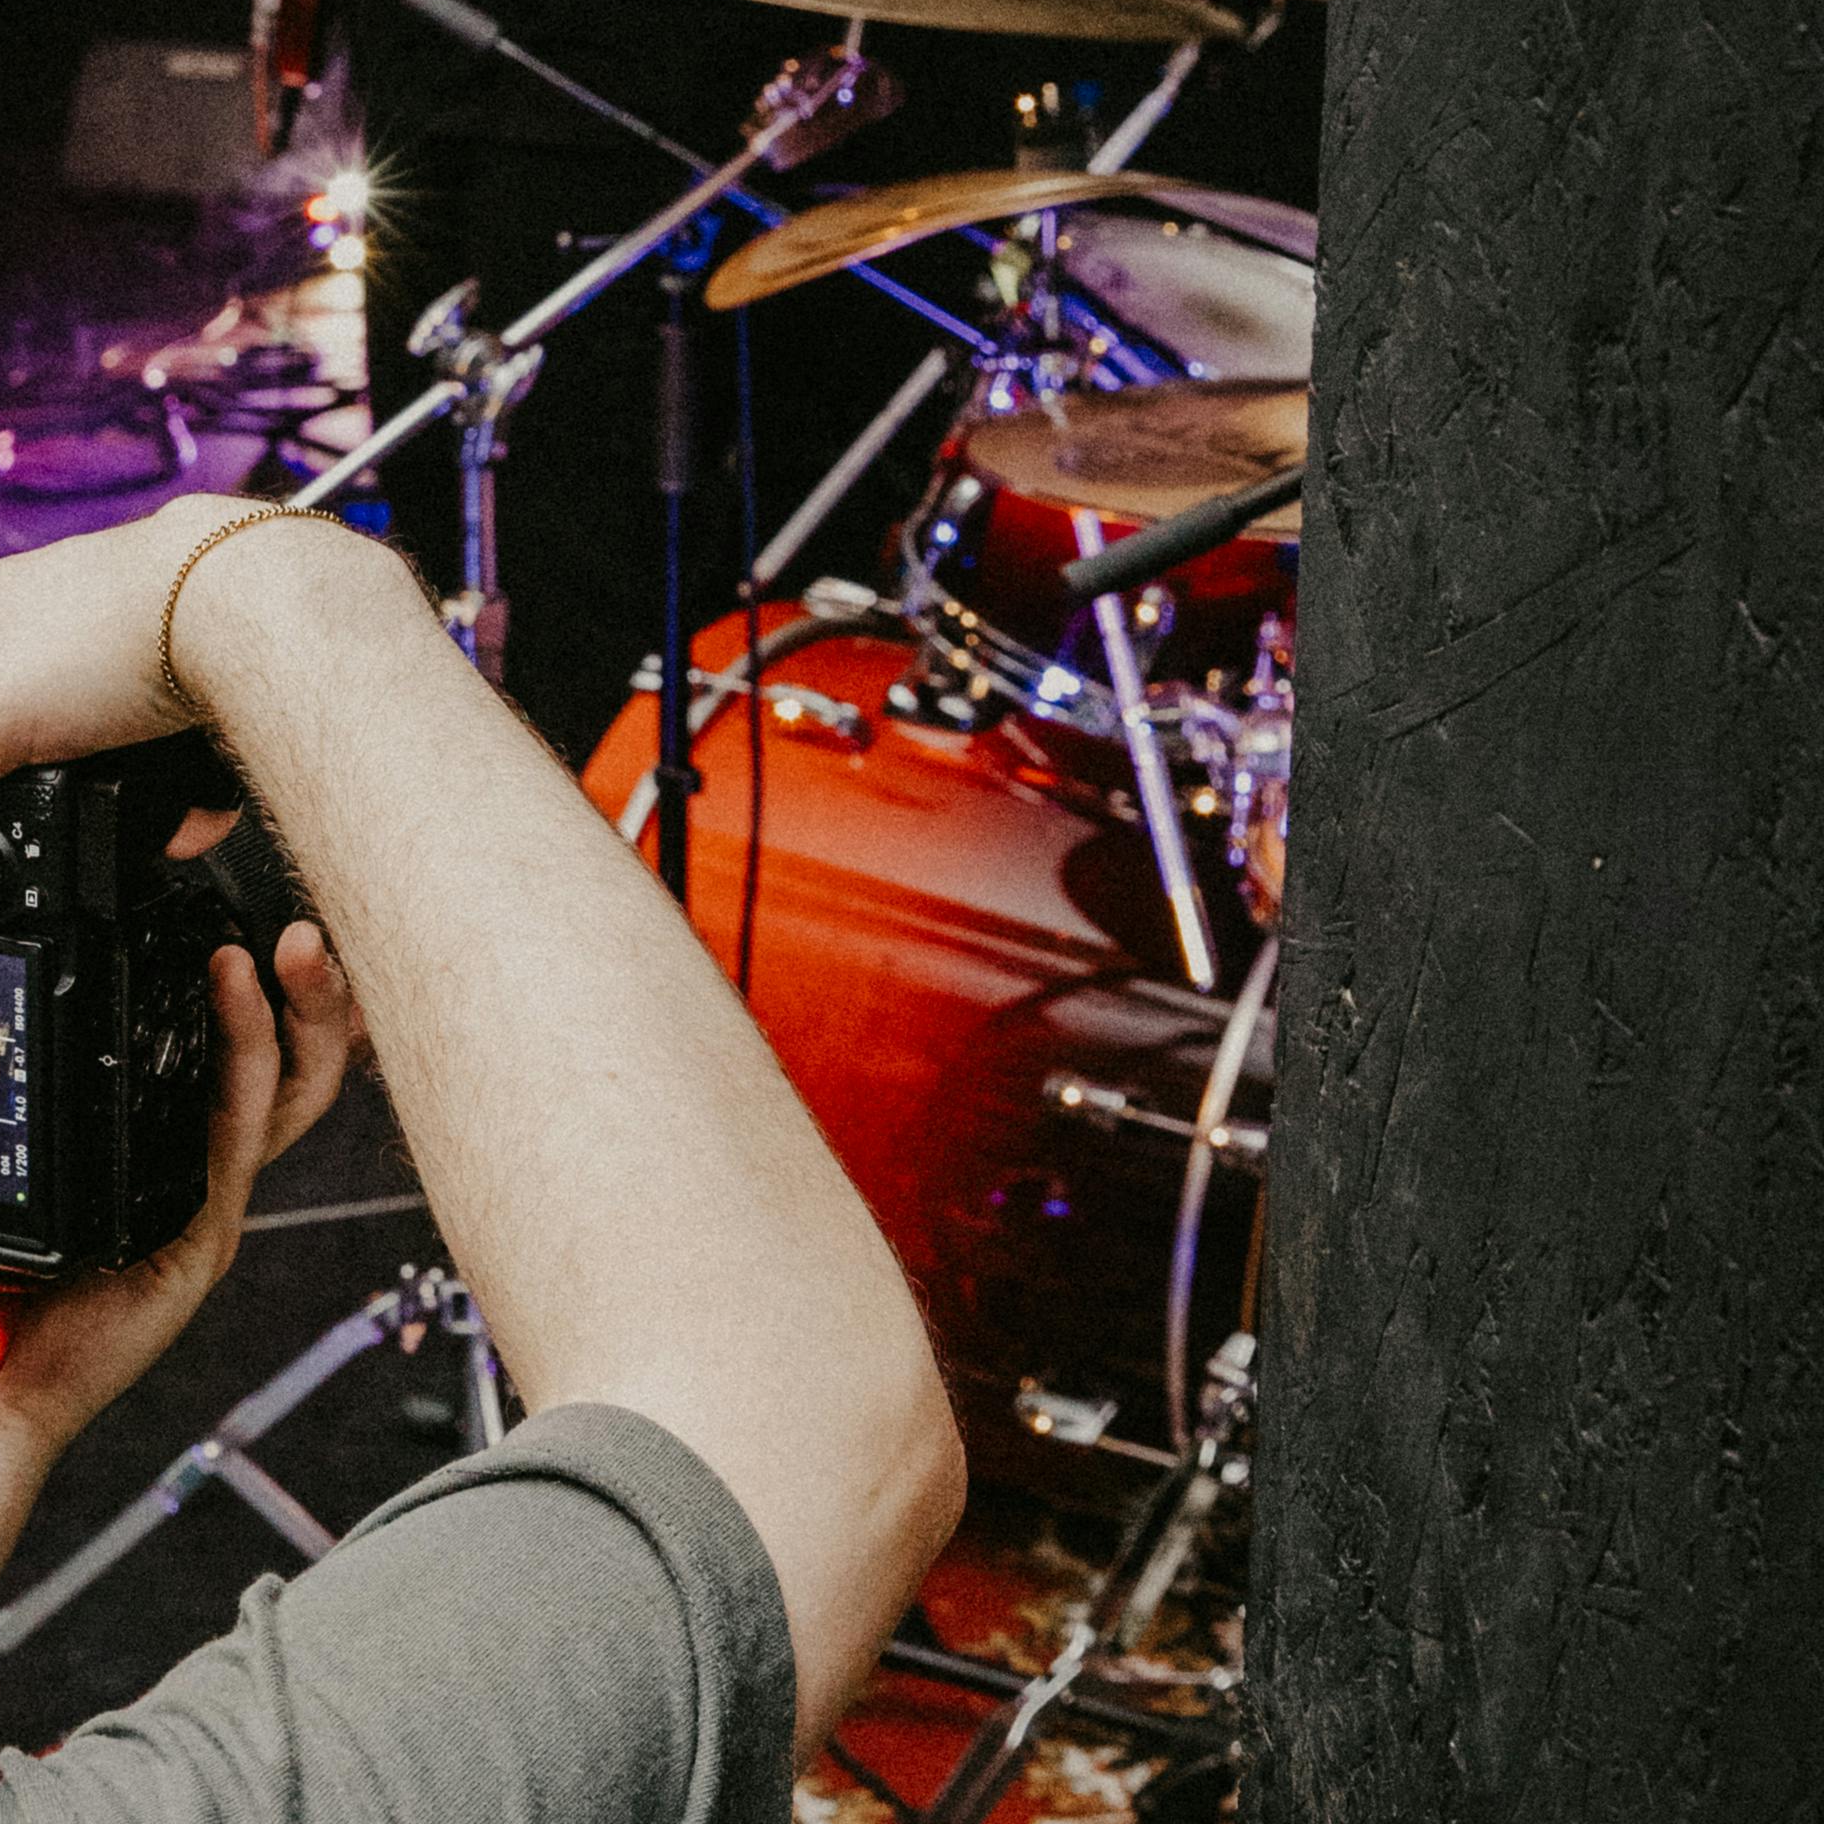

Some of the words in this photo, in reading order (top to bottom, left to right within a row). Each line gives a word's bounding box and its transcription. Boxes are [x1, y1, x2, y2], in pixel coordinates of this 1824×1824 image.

[11, 821, 24, 840] C4
[14, 1095, 27, 1122] F4.0
[15, 1143, 28, 1177] 1/200
